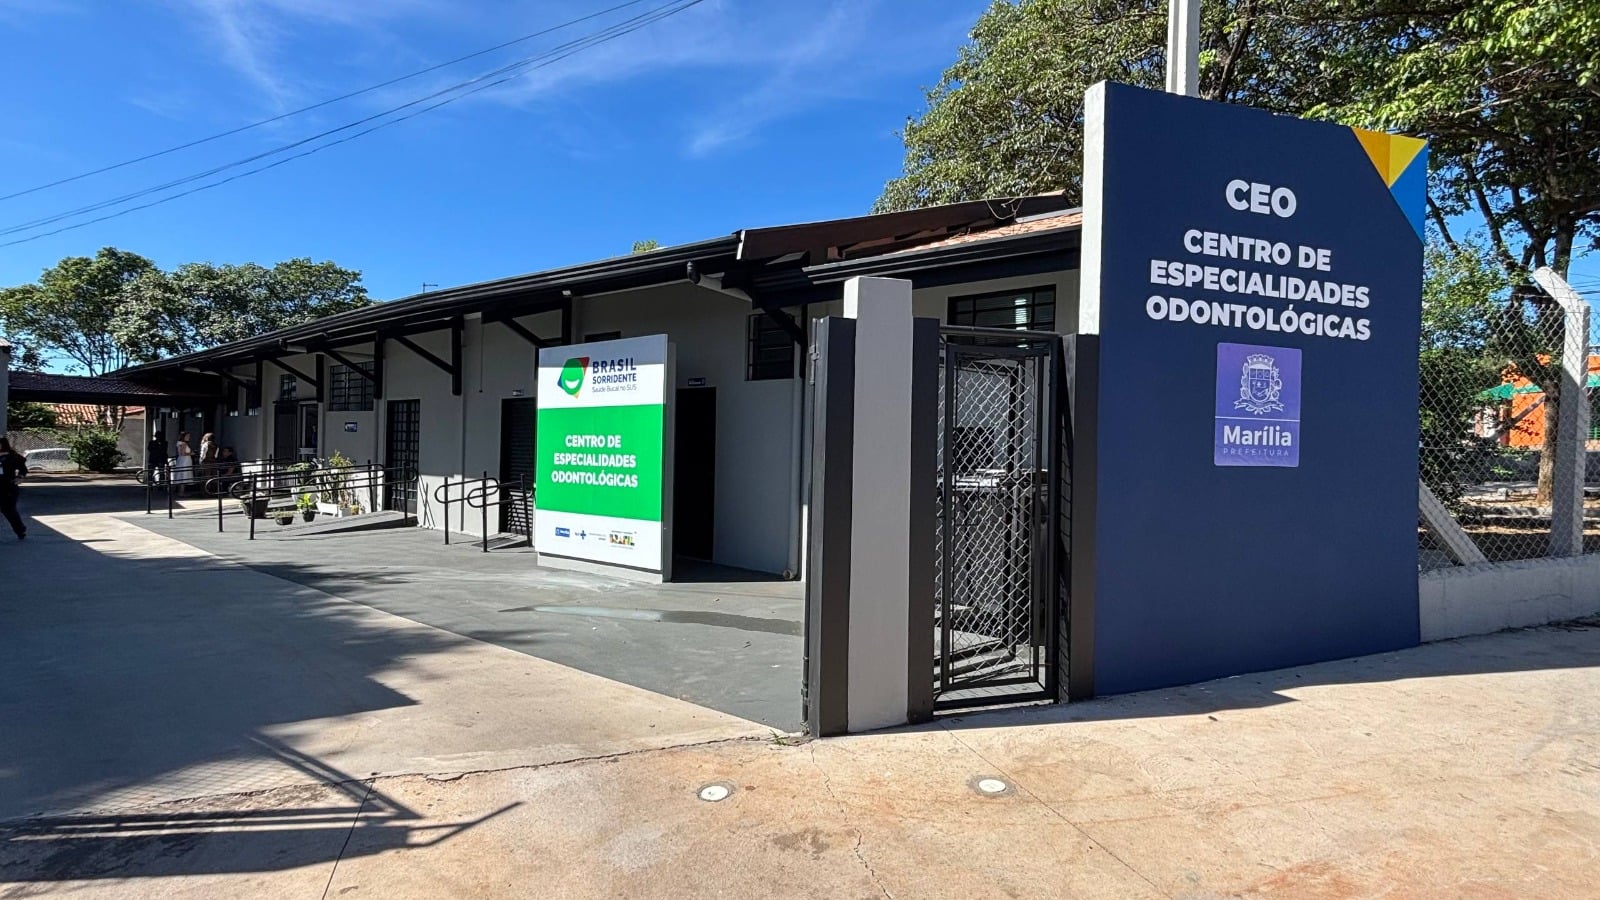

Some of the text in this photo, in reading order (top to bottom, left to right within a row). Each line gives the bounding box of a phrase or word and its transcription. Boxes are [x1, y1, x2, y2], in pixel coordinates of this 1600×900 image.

[1225, 179, 1297, 218] CEO
[1183, 229, 1332, 272] CENTRO DE
[1150, 259, 1371, 309] ESPECIALIDADES
[1146, 295, 1371, 341] ODONTOLÓGICAS
[592, 357, 637, 374] BRASIL
[592, 373, 637, 385] SORRIDENTE
[565, 435, 622, 448] CENTRO DE
[1223, 425, 1292, 447] Marília
[554, 452, 637, 468] ESPECIALIDADES
[1223, 448, 1289, 457] PREFEITURA
[551, 470, 638, 488] ODONTOLÓGICAS
